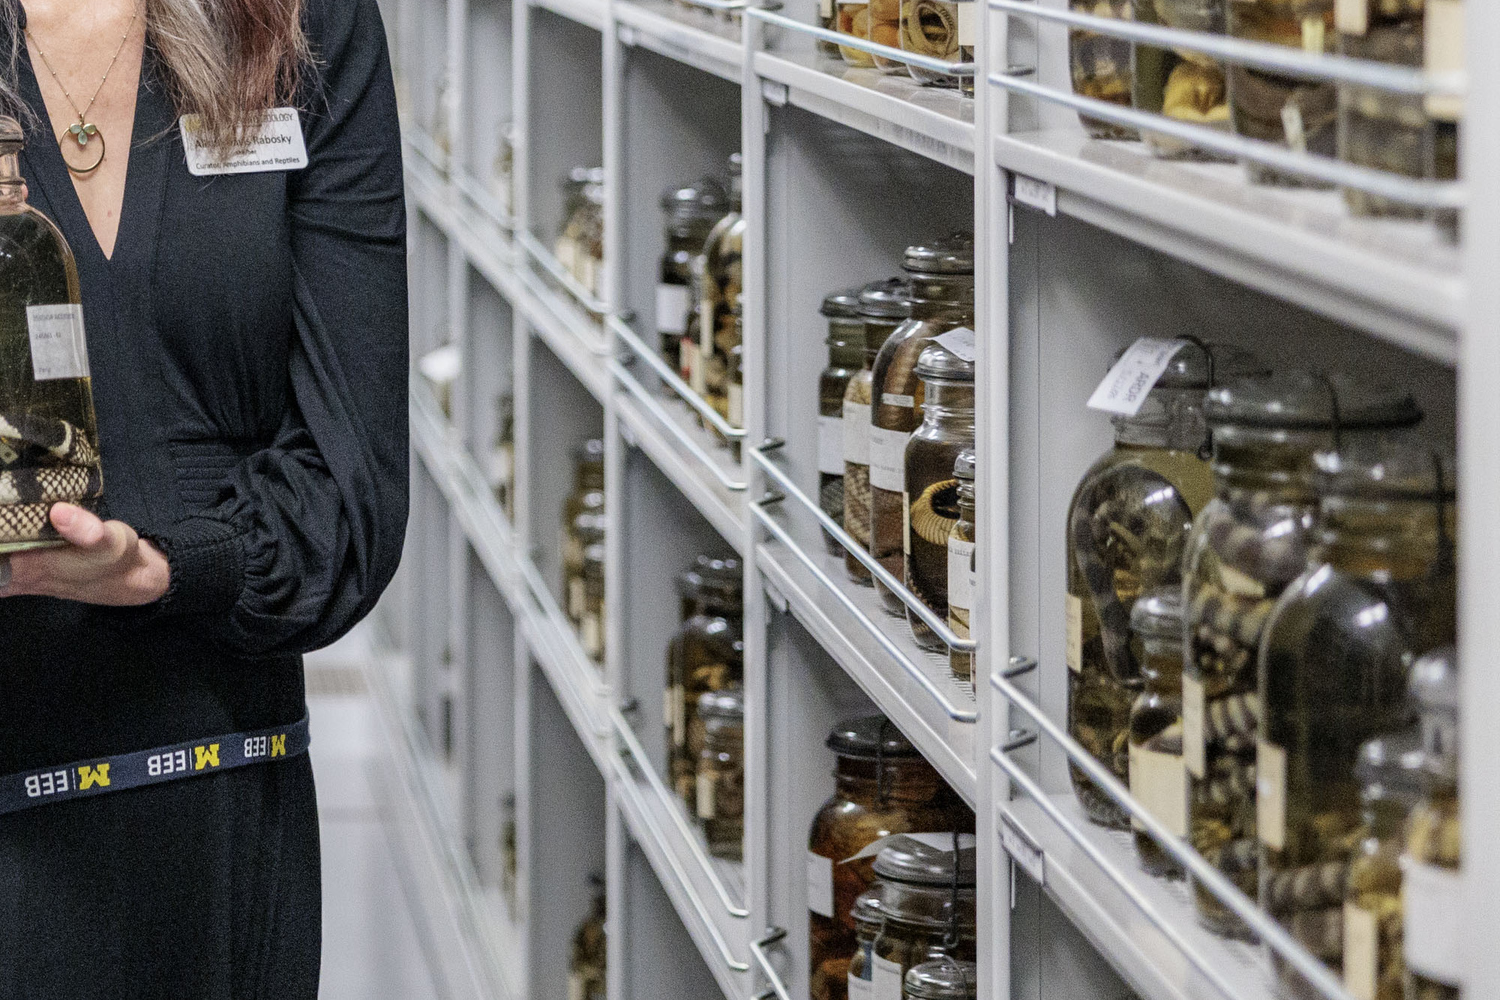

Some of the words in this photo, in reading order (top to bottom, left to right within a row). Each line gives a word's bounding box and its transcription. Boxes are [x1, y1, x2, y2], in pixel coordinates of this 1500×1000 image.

[252, 134, 292, 145] Rabosky
[274, 156, 301, 165] Reptiles
[194, 743, 220, 771] M
[243, 736, 267, 758] EEB
[271, 734, 287, 757] M
[147, 749, 187, 777] EEB
[24, 770, 70, 798] EEB
[77, 762, 112, 790] M
